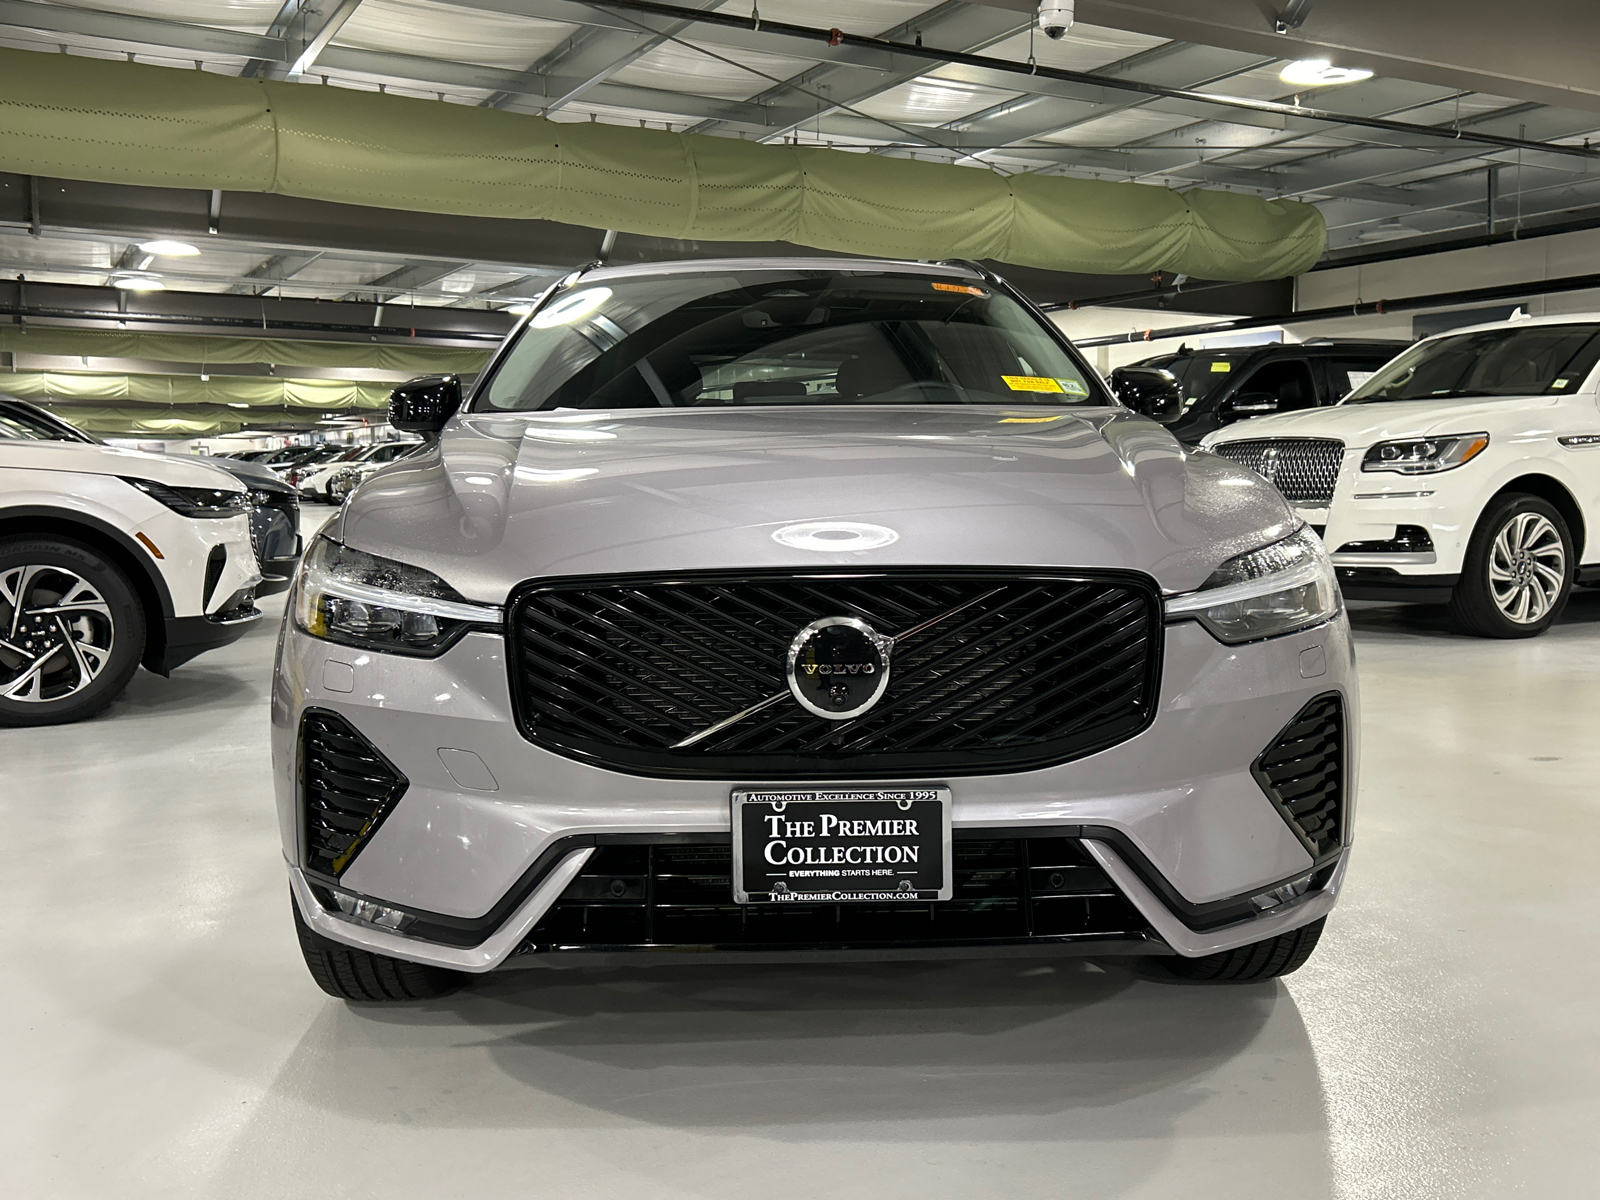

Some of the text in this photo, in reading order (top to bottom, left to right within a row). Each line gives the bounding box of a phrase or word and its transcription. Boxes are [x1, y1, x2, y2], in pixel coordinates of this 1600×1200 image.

[801, 663, 875, 675] VOLVO
[748, 791, 936, 802] AUTOMOTIVE EXCELLENCE SINCE 1995
[764, 814, 920, 838] THE PREMIER
[764, 840, 920, 865] COLLECTION
[788, 870, 840, 878] EVERYTHING
[841, 869, 871, 877] STARTS
[768, 891, 919, 902] THEPREMIERCOLLECTION.COM
